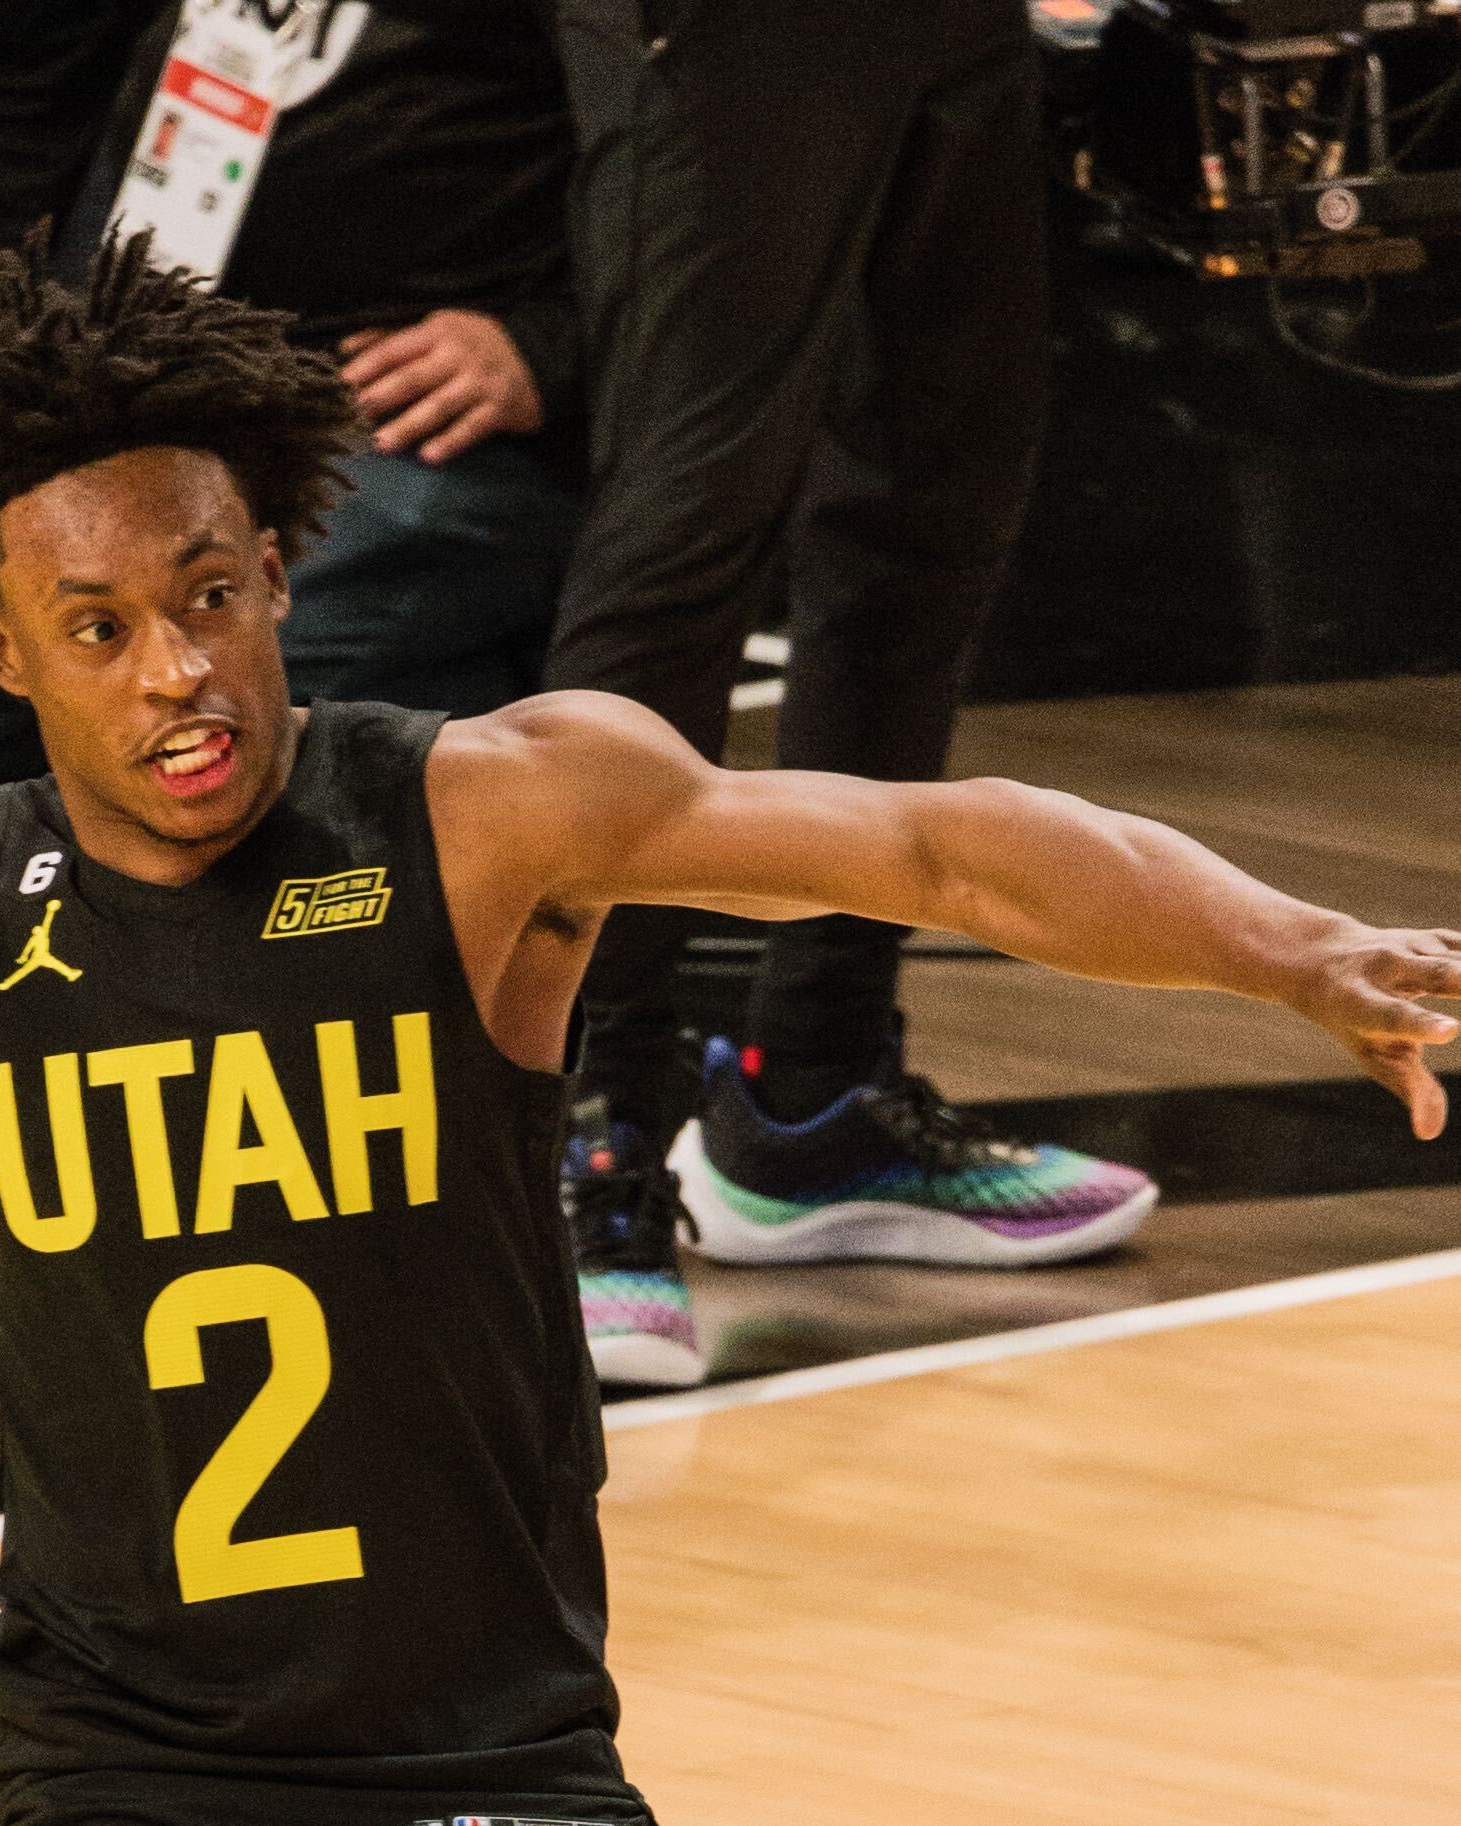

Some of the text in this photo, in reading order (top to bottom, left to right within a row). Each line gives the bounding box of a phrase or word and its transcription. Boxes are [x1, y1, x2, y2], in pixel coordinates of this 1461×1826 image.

[19, 851, 63, 895] 6
[276, 888, 312, 930] 5
[311, 898, 380, 926] FIGHT
[143, 1263, 365, 1604] 2
